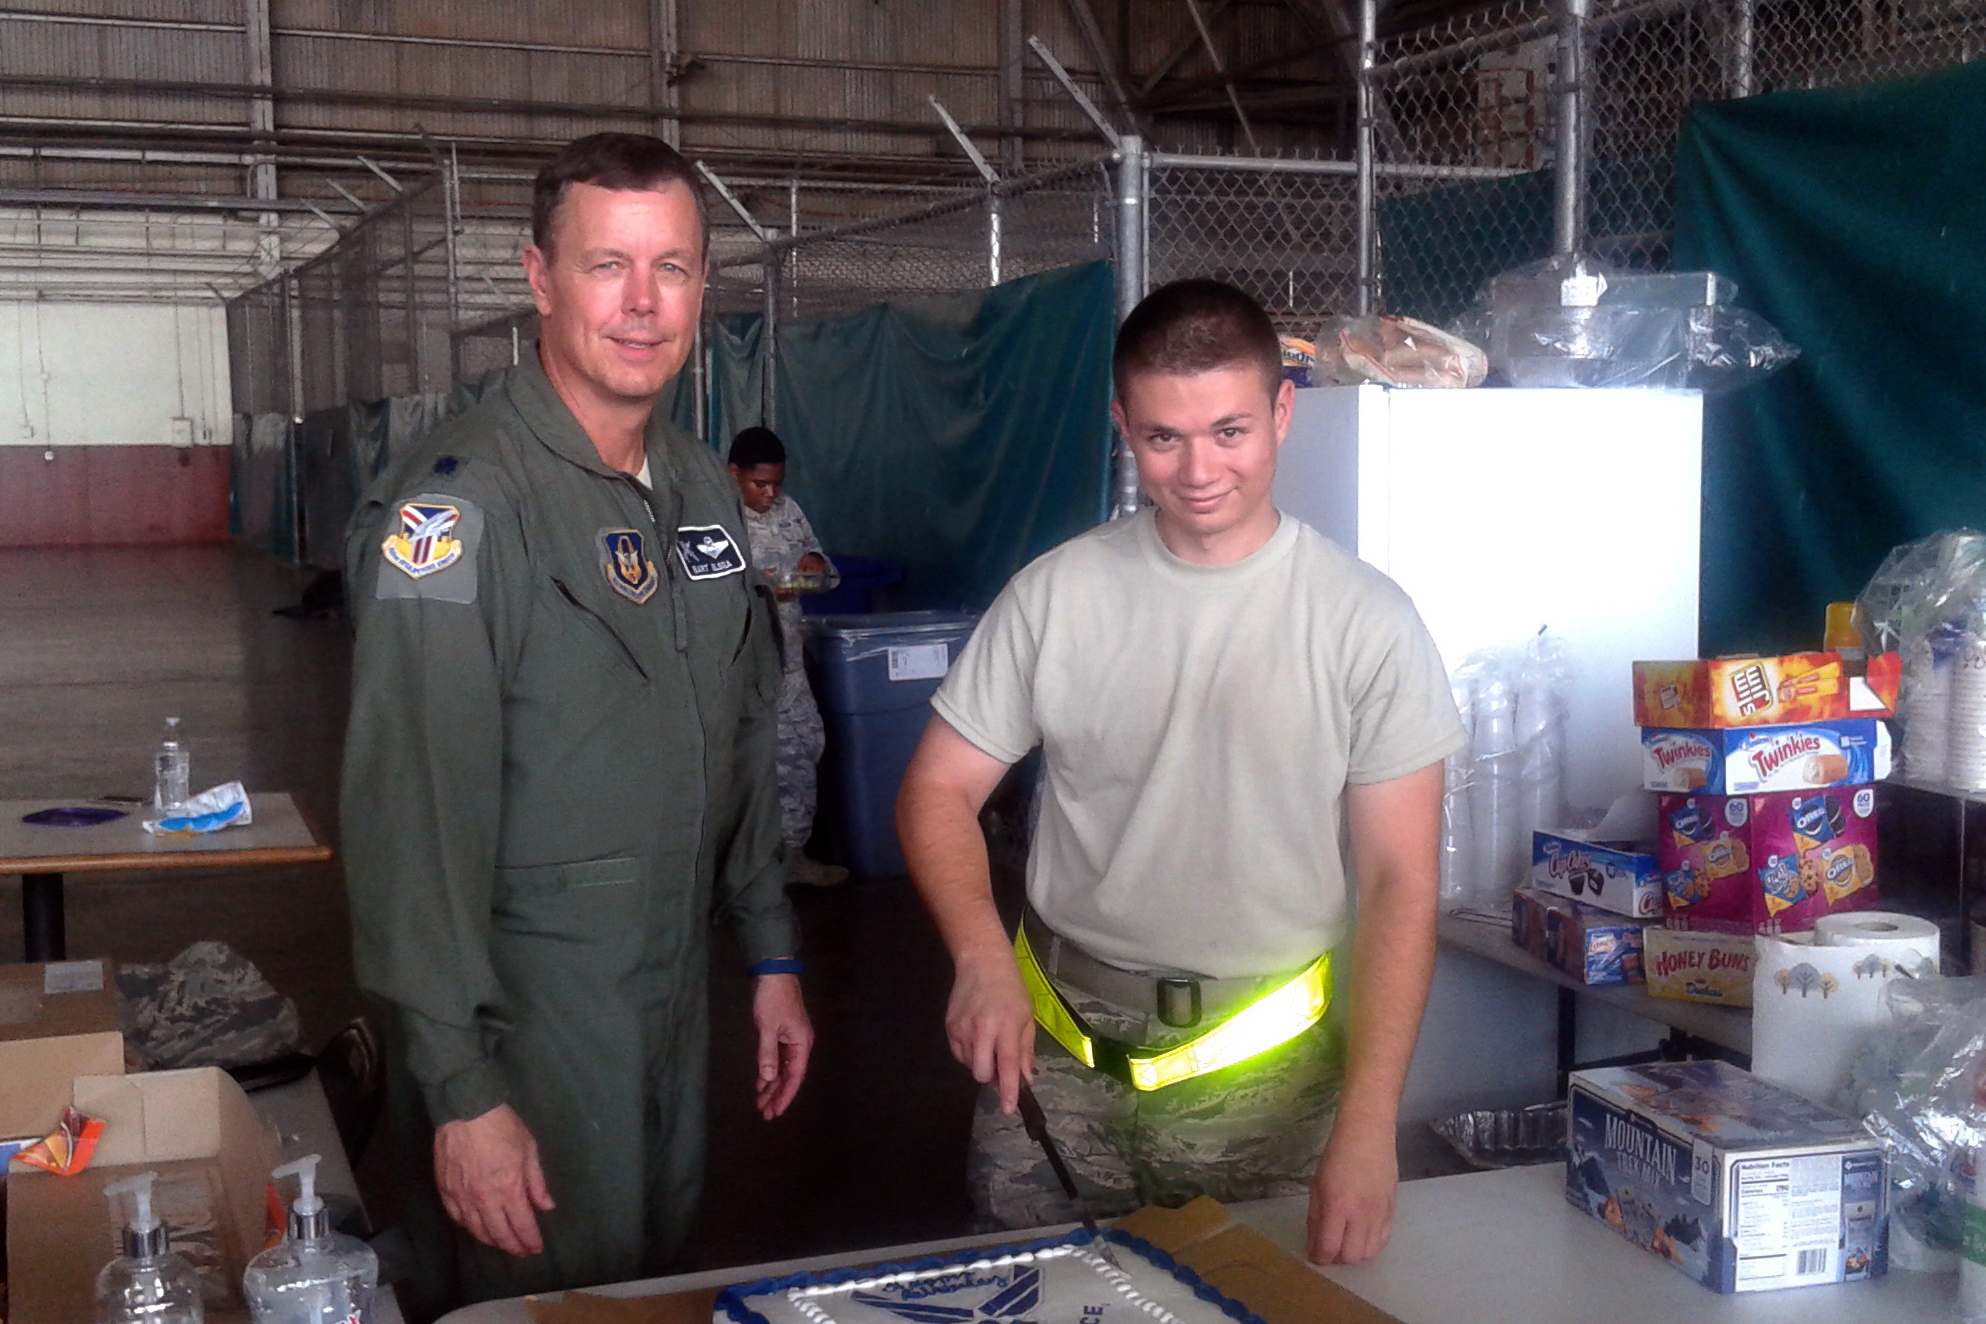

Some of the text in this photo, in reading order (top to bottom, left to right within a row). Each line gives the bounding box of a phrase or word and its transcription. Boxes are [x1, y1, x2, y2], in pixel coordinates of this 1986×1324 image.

[1653, 742, 1711, 769] Twinkies
[1752, 733, 1821, 777] Twinkies
[1857, 792, 1871, 803] 60
[1797, 808, 1825, 829] OREO
[1827, 858, 1855, 879] OREO
[1655, 948, 1750, 978] HONEY BUNS
[1604, 1113, 1677, 1185] MOUNTAIN
[1695, 1156, 1710, 1175] 30
